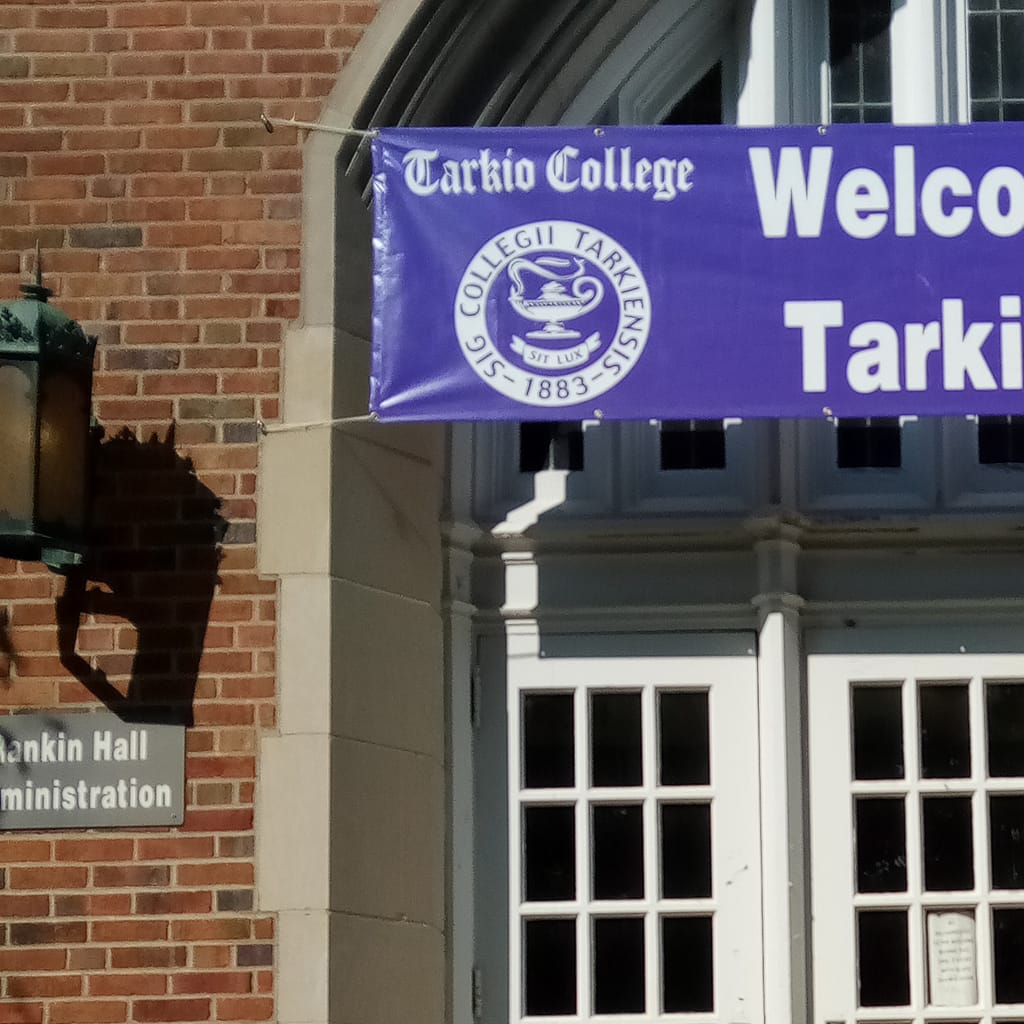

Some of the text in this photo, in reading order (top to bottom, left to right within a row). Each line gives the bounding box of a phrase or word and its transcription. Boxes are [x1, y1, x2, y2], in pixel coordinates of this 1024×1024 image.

[402, 145, 695, 201] Tarkio College
[460, 225, 554, 318] COLLEGII
[575, 228, 645, 377] TARKIENSIS
[528, 349, 583, 365] SIT LUX
[93, 730, 148, 762] Hall
